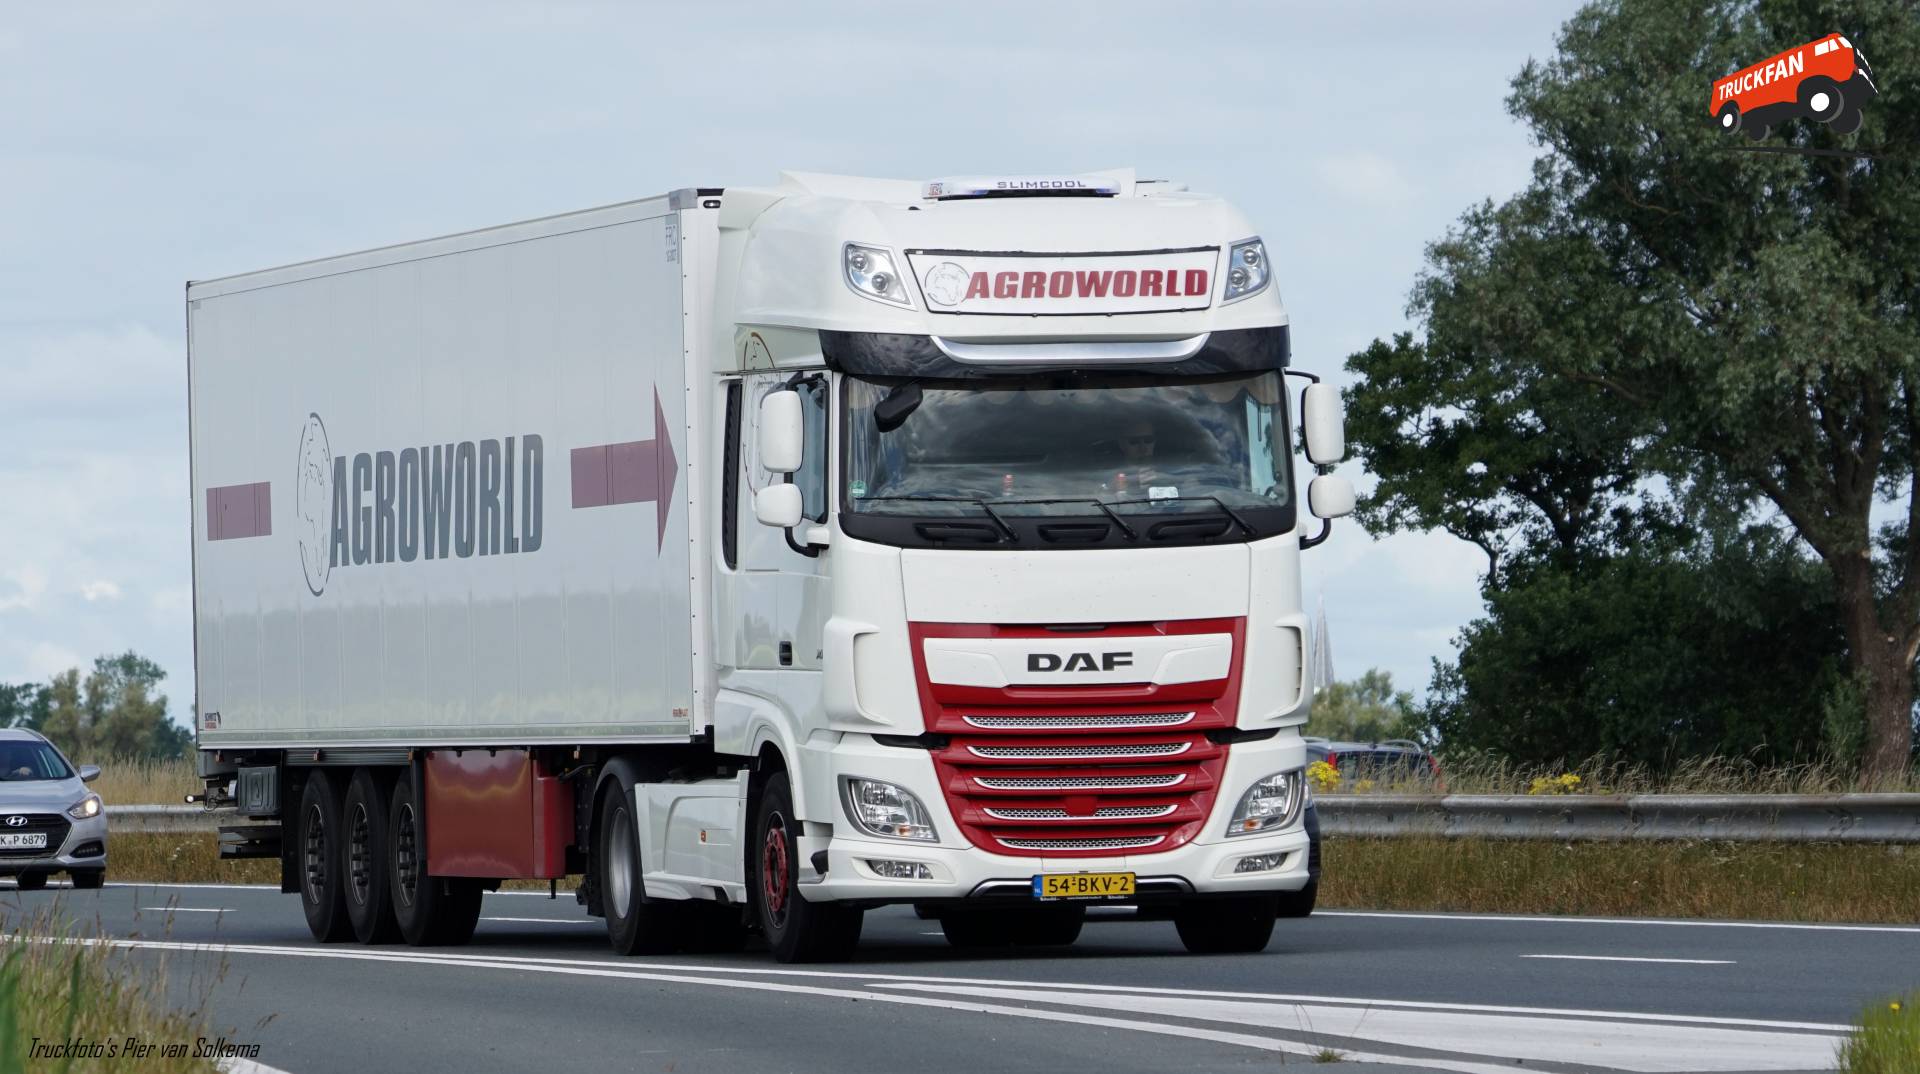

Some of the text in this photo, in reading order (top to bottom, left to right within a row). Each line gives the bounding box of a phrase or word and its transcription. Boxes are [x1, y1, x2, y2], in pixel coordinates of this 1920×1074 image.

[997, 180, 1087, 189] SLIMCOOL
[965, 269, 1208, 299] AGROWORLD
[329, 434, 544, 568] AGROWORLD
[1027, 652, 1133, 672] DAF
[13, 835, 20, 845] P
[22, 835, 46, 845] 6879
[1049, 876, 1129, 893] 54-BKV-2
